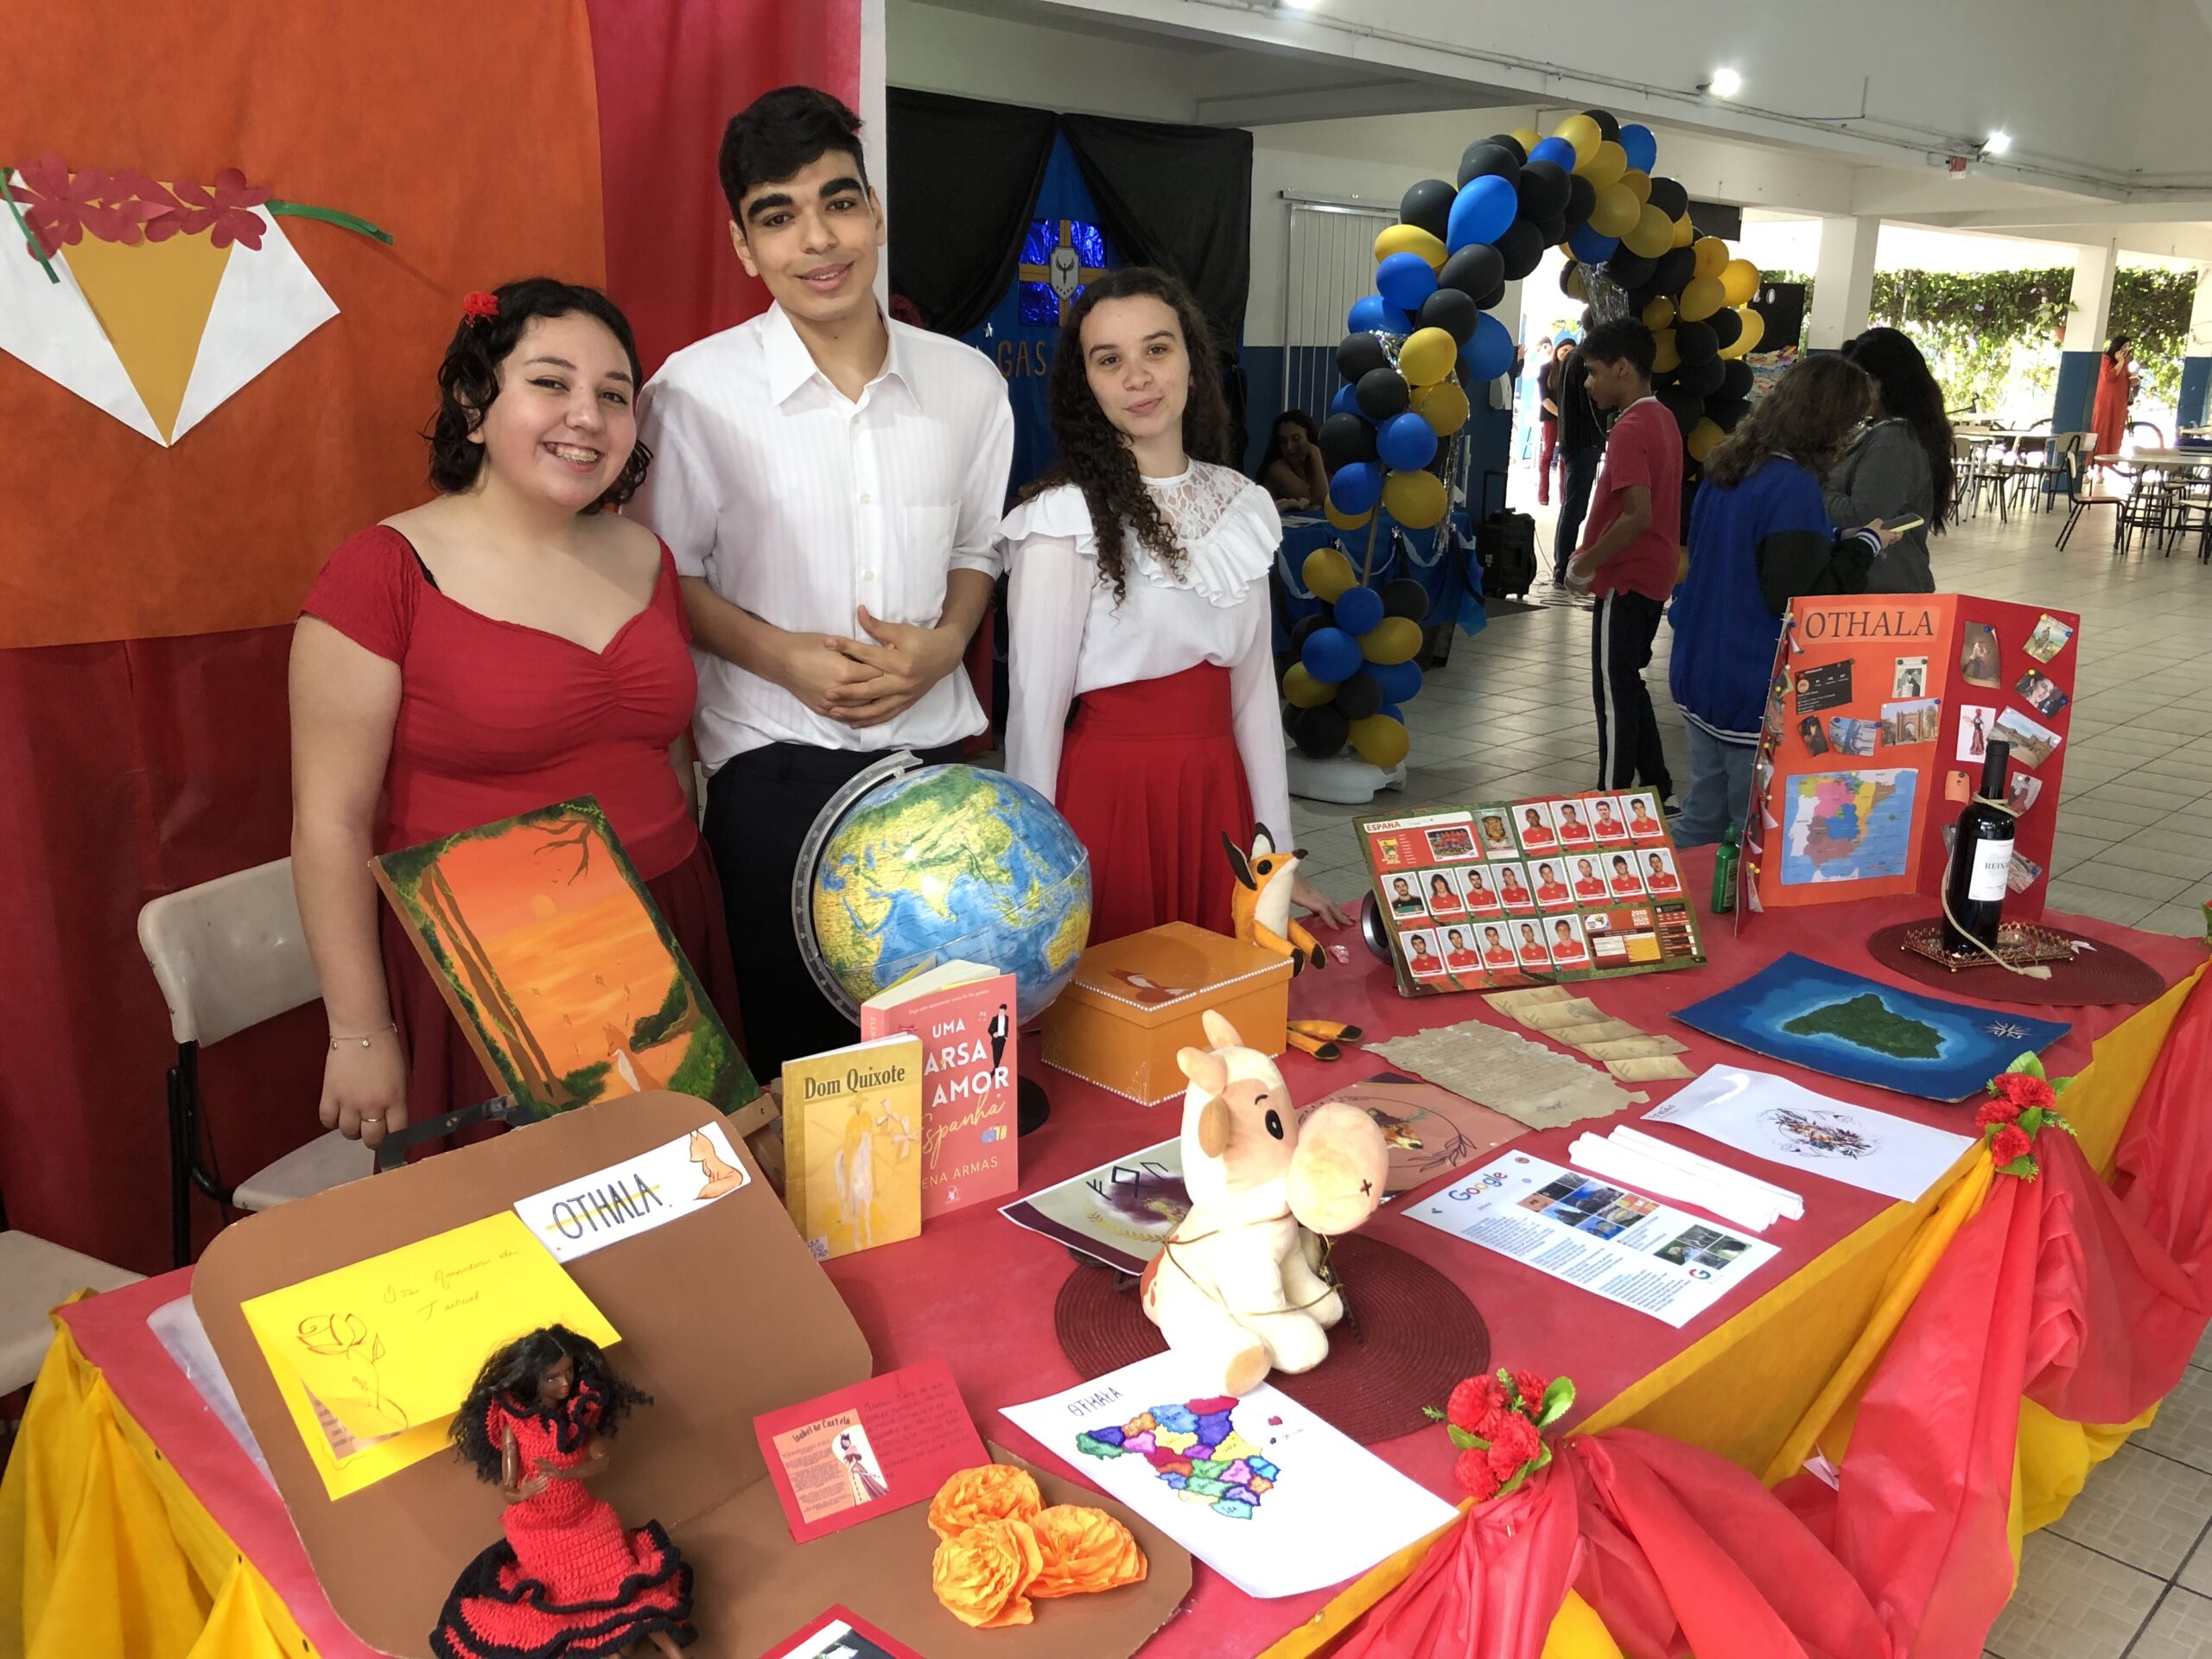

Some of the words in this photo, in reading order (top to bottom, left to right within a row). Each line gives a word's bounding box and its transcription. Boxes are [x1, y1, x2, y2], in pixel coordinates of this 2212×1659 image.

[997, 340, 1046, 378] GAS
[1805, 610, 1935, 639] OTHALA
[931, 1018, 965, 1039] UMA
[924, 1038, 988, 1077] ARSA
[804, 1077, 842, 1100] Dom
[847, 1065, 906, 1093] Quixote
[931, 1066, 1009, 1108] AMOR
[922, 1172, 948, 1190] ENA
[952, 1156, 998, 1179] ARMAS
[1448, 1172, 1508, 1201] Google
[552, 1173, 664, 1239] OTHALA
